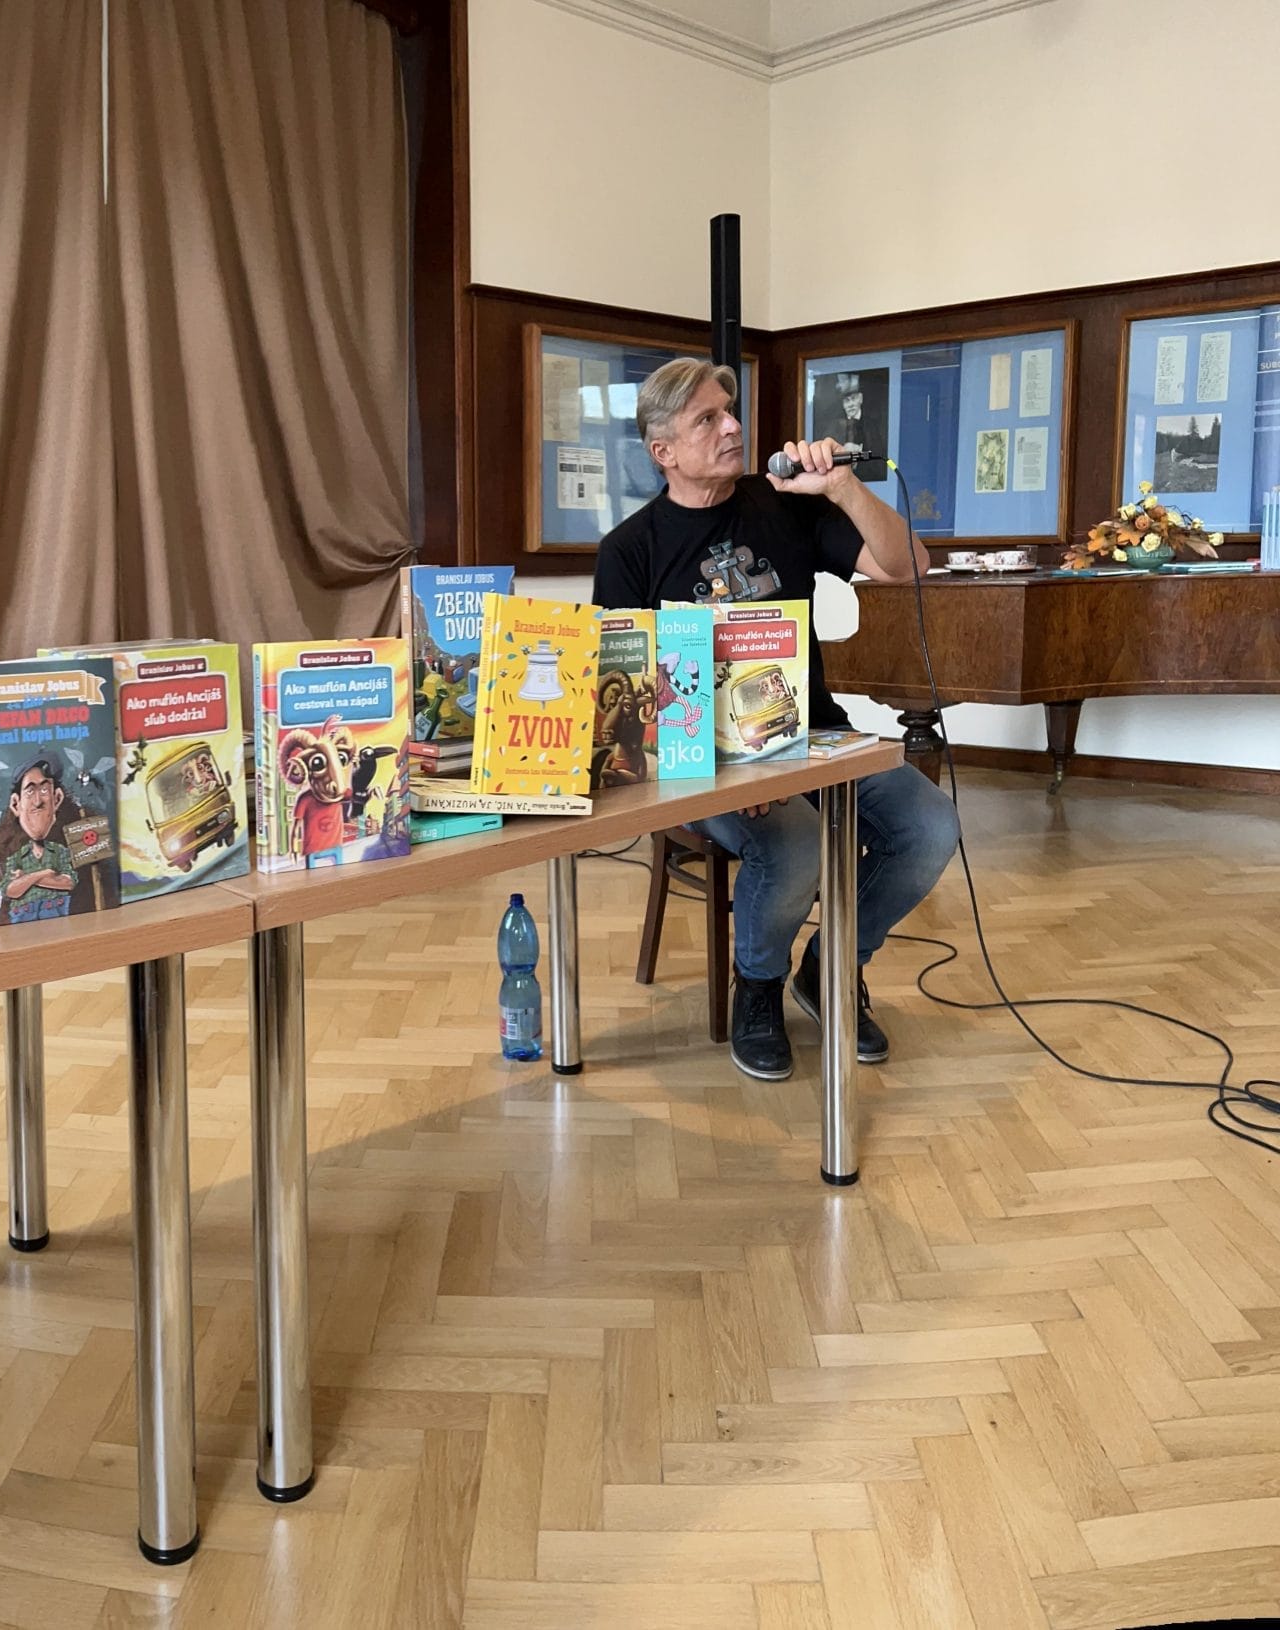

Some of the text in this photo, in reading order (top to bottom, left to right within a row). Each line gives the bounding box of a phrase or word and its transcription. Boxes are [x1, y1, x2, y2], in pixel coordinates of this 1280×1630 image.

[434, 591, 486, 617] ZBERN
[514, 620, 580, 638] Branislav Jobus
[657, 621, 699, 634] Jobus
[718, 629, 793, 641] Ako muflón Ancijáš
[749, 642, 780, 651] dodržal
[302, 654, 361, 665] Branislav Jobus
[140, 665, 174, 675] Branislav
[47, 679, 80, 692] Jobus
[285, 678, 388, 696] Ako muflón Ancijáš
[126, 688, 222, 710] Ako muflón Ancijáš
[293, 699, 335, 710] cestoval
[350, 694, 379, 707] západ
[168, 707, 207, 722] dodržal
[22, 727, 53, 745] kopu
[508, 715, 573, 748] ZVON
[658, 740, 705, 770] ajko
[425, 798, 477, 808] MUZIKANT
